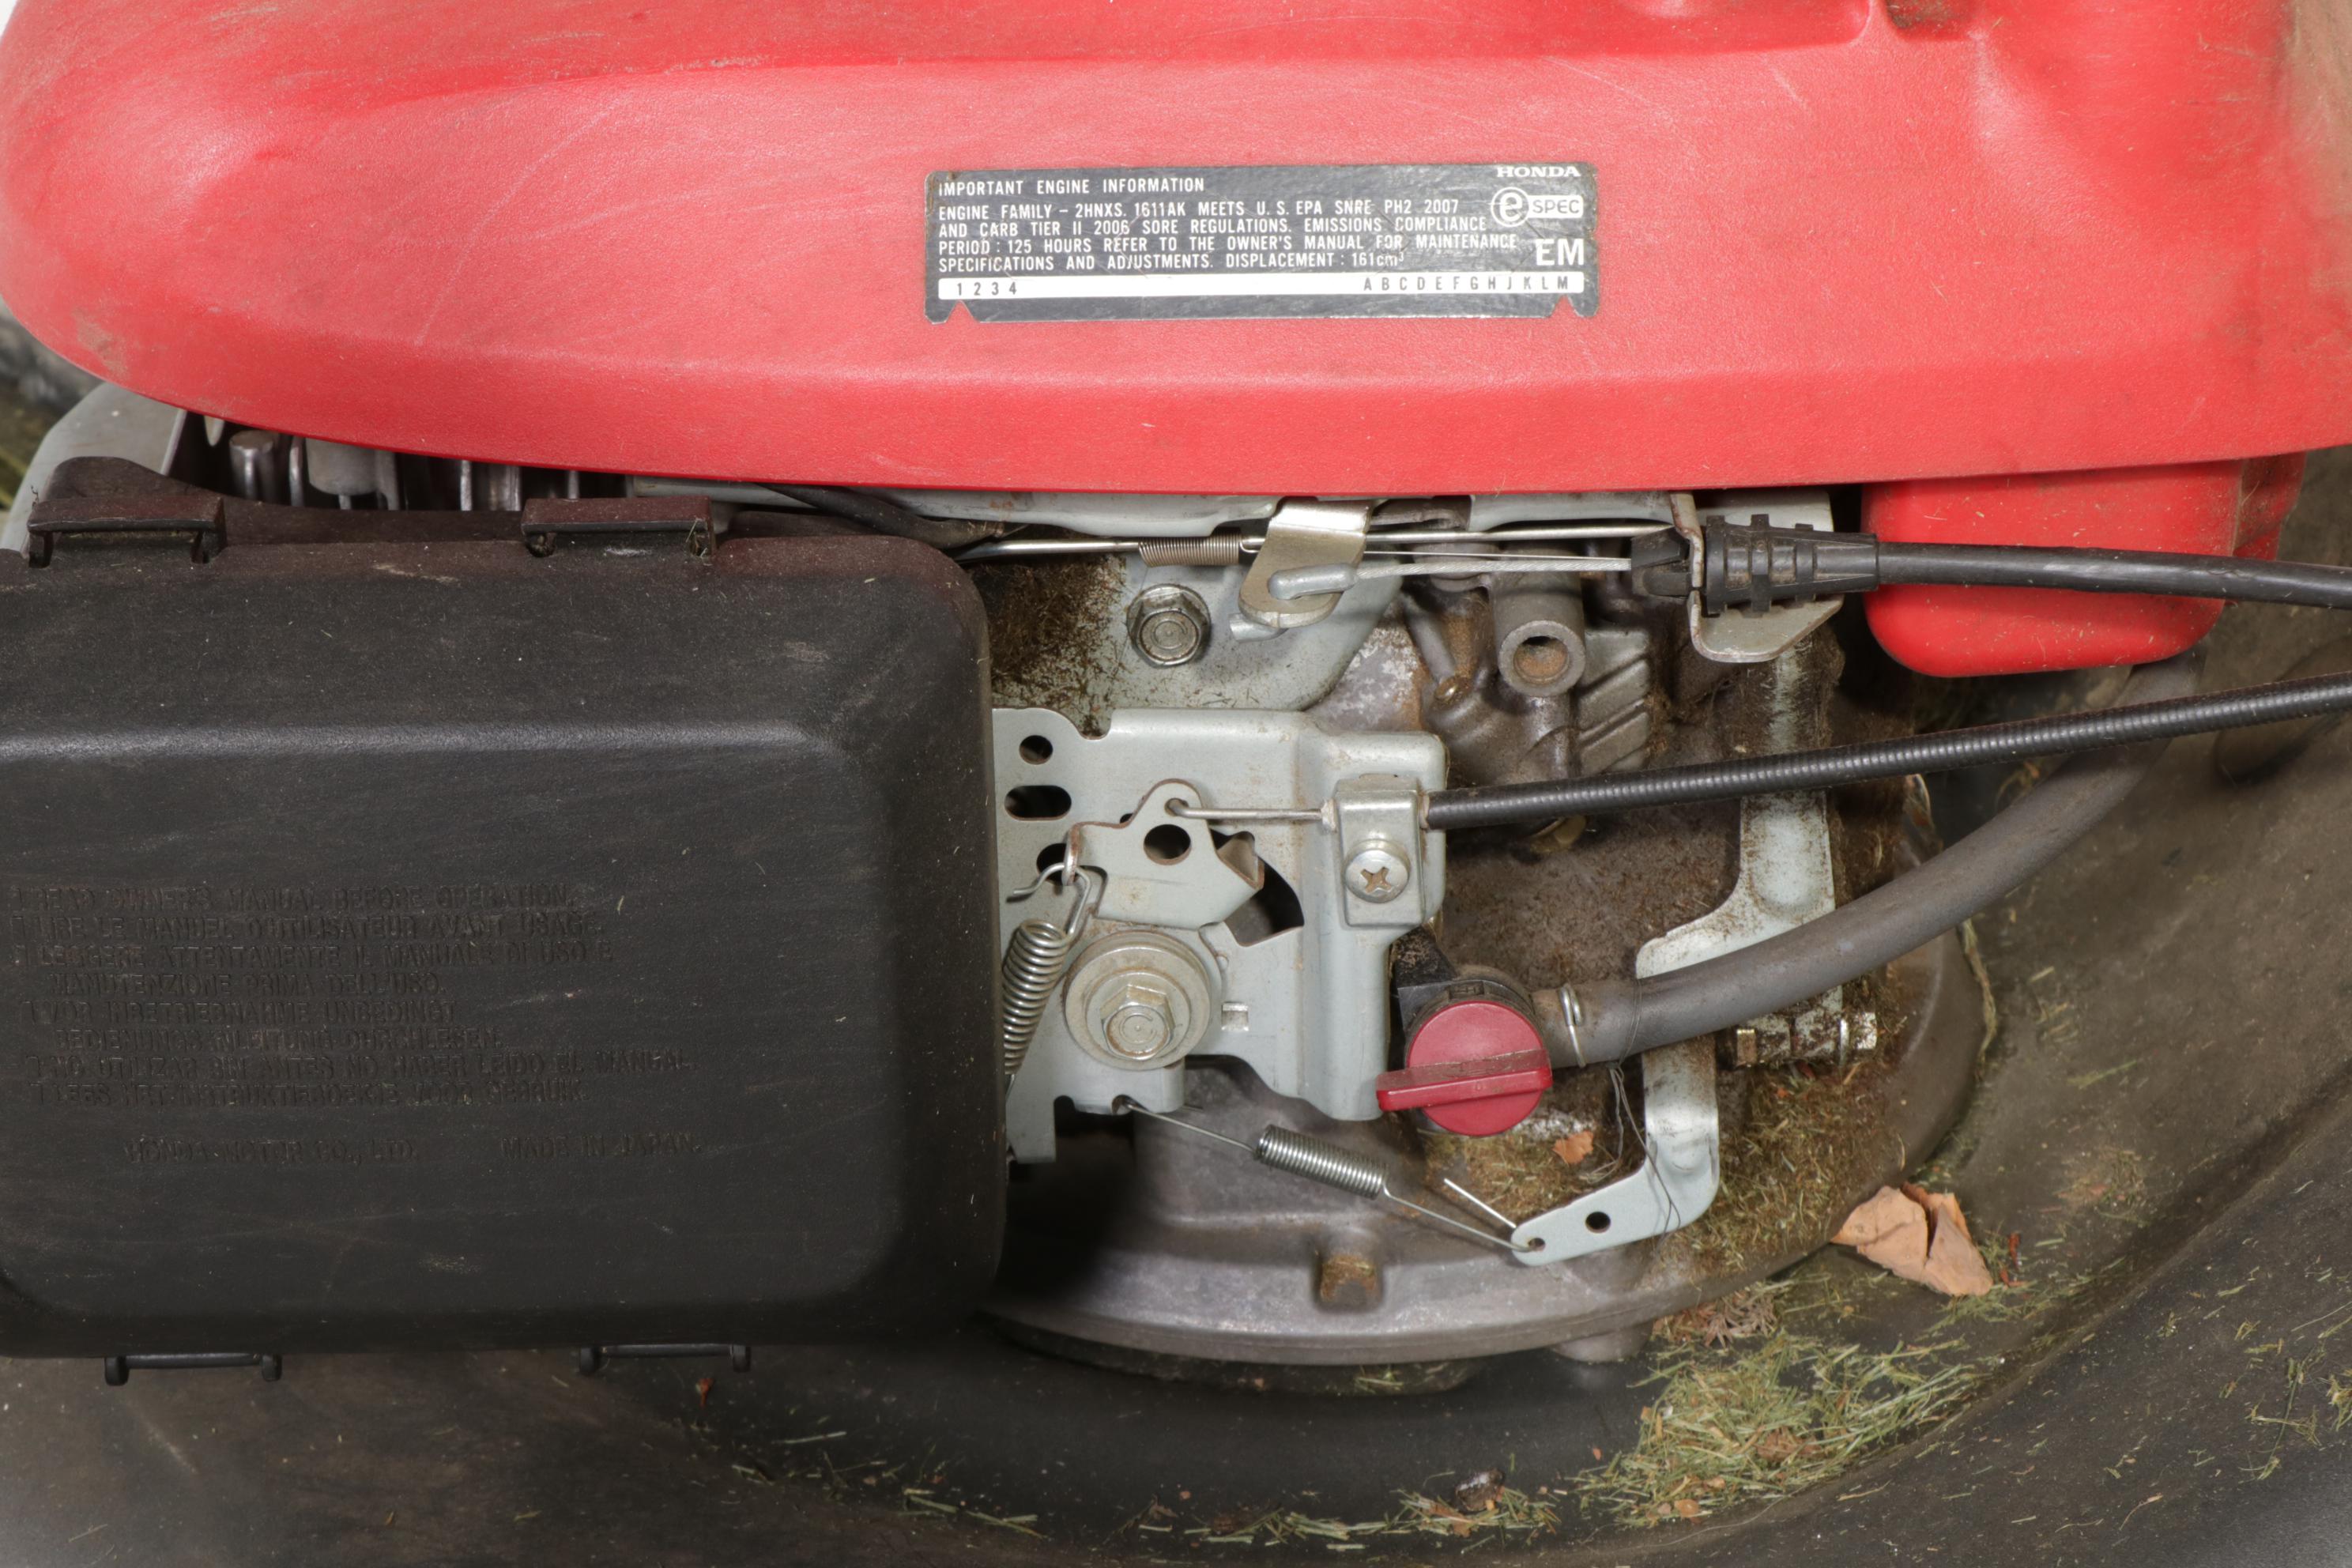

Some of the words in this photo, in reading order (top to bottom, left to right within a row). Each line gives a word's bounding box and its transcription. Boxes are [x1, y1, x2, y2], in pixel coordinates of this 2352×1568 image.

[1497, 166, 1581, 178] HONDA
[939, 180, 1023, 195] IMPORTANT
[1037, 179, 1089, 194] ENGINE
[1103, 178, 1204, 193] INFORMATION
[939, 205, 989, 220] ENGINE
[1001, 204, 1052, 219] FAMILY
[1198, 202, 1244, 216] MEETS
[1335, 200, 1372, 213] SNRE
[1385, 200, 1412, 213] PH2
[1424, 199, 1458, 213] 2007
[1499, 191, 1523, 221] e
[1532, 199, 1579, 213] SPEC
[939, 223, 967, 238] AND
[980, 222, 1018, 237] CARB
[1031, 220, 1060, 236] TIER
[1073, 220, 1081, 236] II
[1095, 220, 1129, 236] 2006
[1143, 220, 1178, 234] SORE
[1190, 218, 1291, 234] REGULATIONS.
[1304, 217, 1381, 232] EMISSIONS
[1395, 217, 1486, 231] COMPLIANCE
[1008, 239, 1031, 254] 125
[1044, 239, 1091, 253] HOURS
[1104, 238, 1147, 252] REFER
[1159, 237, 1176, 251] TO
[1189, 237, 1215, 251] THE
[1227, 236, 1292, 250] OWNER'S
[1304, 236, 1364, 250] MANUAL
[1376, 235, 1402, 249] FOR
[1415, 234, 1517, 248] MAINTENANCE
[1536, 238, 1585, 266] EM
[939, 256, 1054, 273] SPECIFICATIONS
[1066, 255, 1095, 270] AND
[1107, 254, 1213, 270] ADJUSTMENTS.
[957, 283, 962, 296] 1
[974, 283, 981, 296] 2
[991, 282, 999, 295] 3
[1009, 281, 1016, 295] 4
[1364, 278, 1372, 291] A
[1382, 277, 1389, 290] B
[1400, 277, 1407, 290] C
[1418, 277, 1425, 290] D
[1435, 277, 1442, 289] E
[1453, 277, 1460, 289] F
[1470, 277, 1478, 289] G
[1488, 277, 1496, 289] H
[1506, 277, 1512, 289] J
[1524, 277, 1532, 288] K
[1542, 277, 1549, 288] L
[1557, 277, 1568, 288] M
